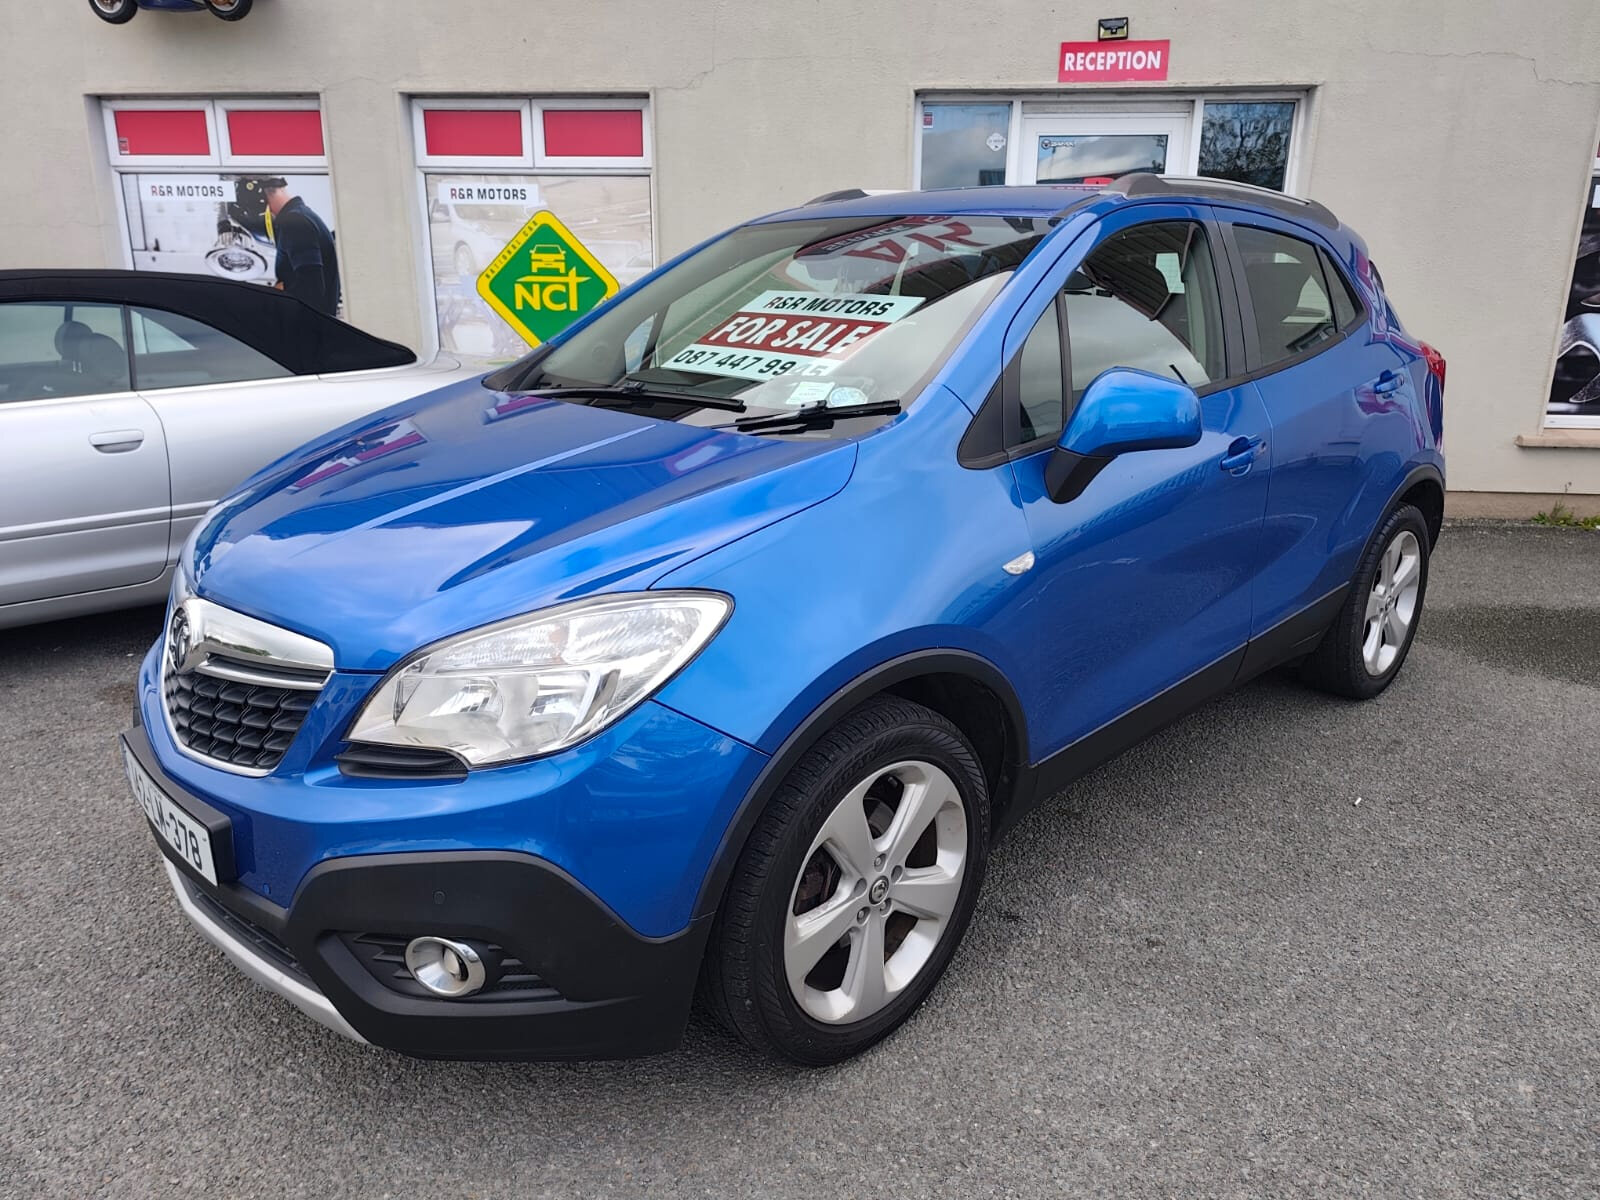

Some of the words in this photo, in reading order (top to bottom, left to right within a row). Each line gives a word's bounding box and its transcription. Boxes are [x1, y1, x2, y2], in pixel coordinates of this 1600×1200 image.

[1064, 50, 1161, 71] RECEPTION
[151, 185, 173, 197] R&R
[176, 185, 224, 197] MOTORS
[450, 188, 473, 200] R&R
[477, 188, 527, 200] MOTORS
[485, 240, 521, 279] NATIONAL
[522, 220, 538, 237] CAR
[763, 296, 807, 310] R&R
[802, 297, 895, 316] MOTORS
[708, 316, 778, 345] FOR
[771, 320, 874, 355] SALE
[673, 349, 719, 366] 087
[716, 354, 763, 371] 447
